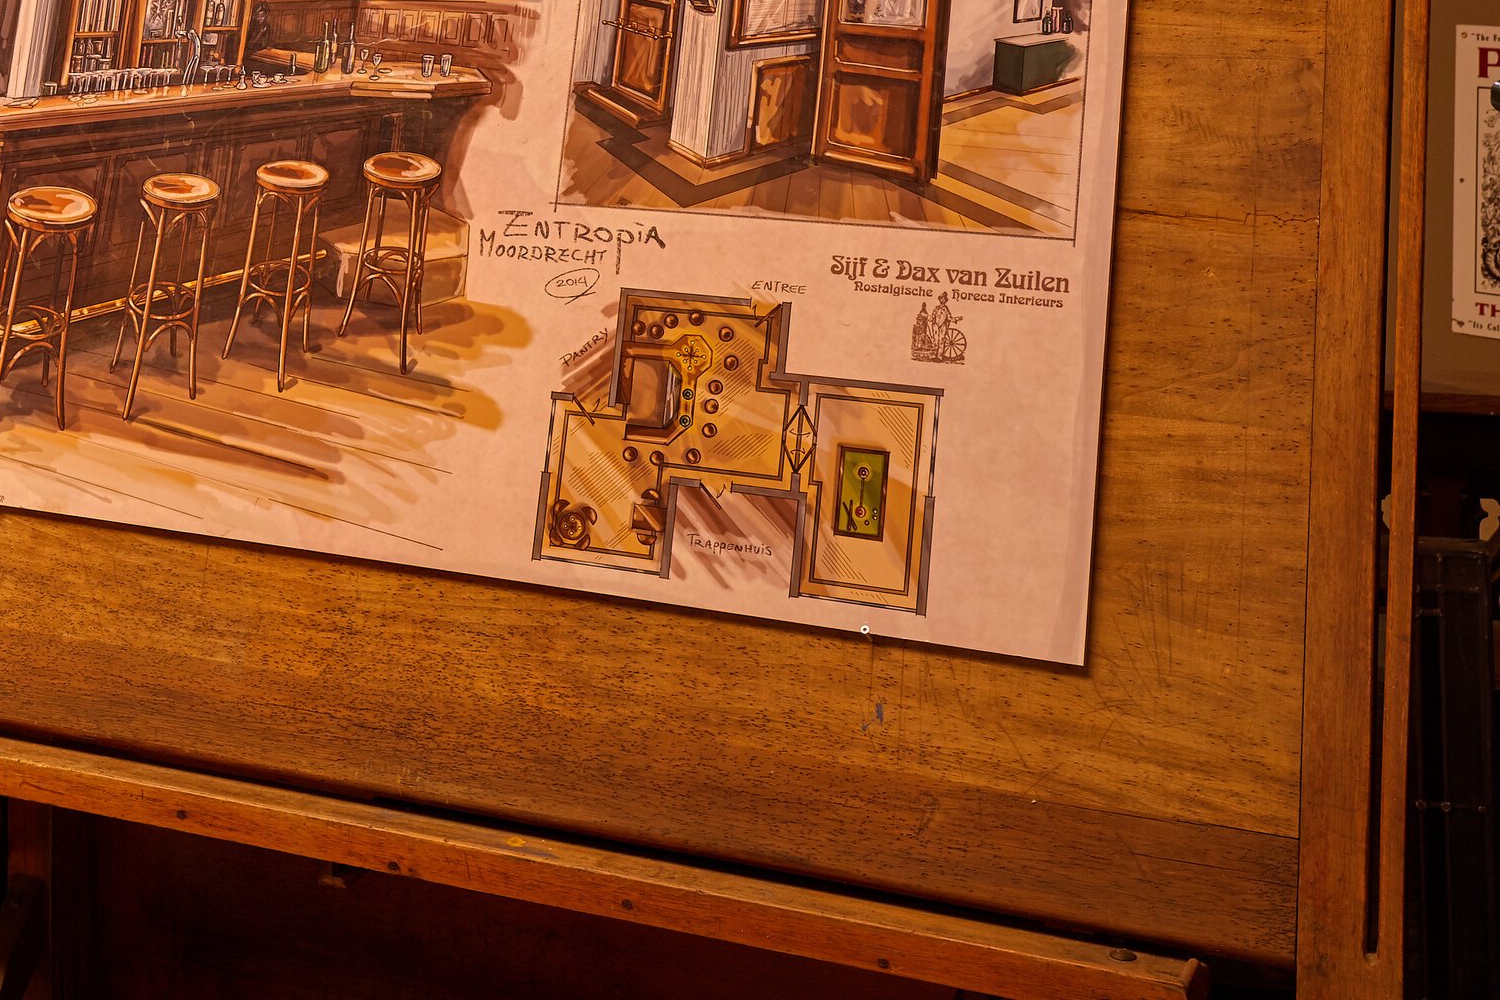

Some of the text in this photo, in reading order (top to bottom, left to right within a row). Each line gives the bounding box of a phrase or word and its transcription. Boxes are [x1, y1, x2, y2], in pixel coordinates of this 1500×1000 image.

[480, 228, 607, 264] MOORDRECHT
[556, 276, 588, 288] 2014
[751, 280, 807, 295] ENTREE
[831, 255, 1070, 293] Sijf & Dax van Zuilen
[853, 281, 1064, 308] Nostalgische Horeca Interieurs
[558, 327, 608, 367] PANTRY
[686, 533, 772, 556] TRAPPENHUIS
